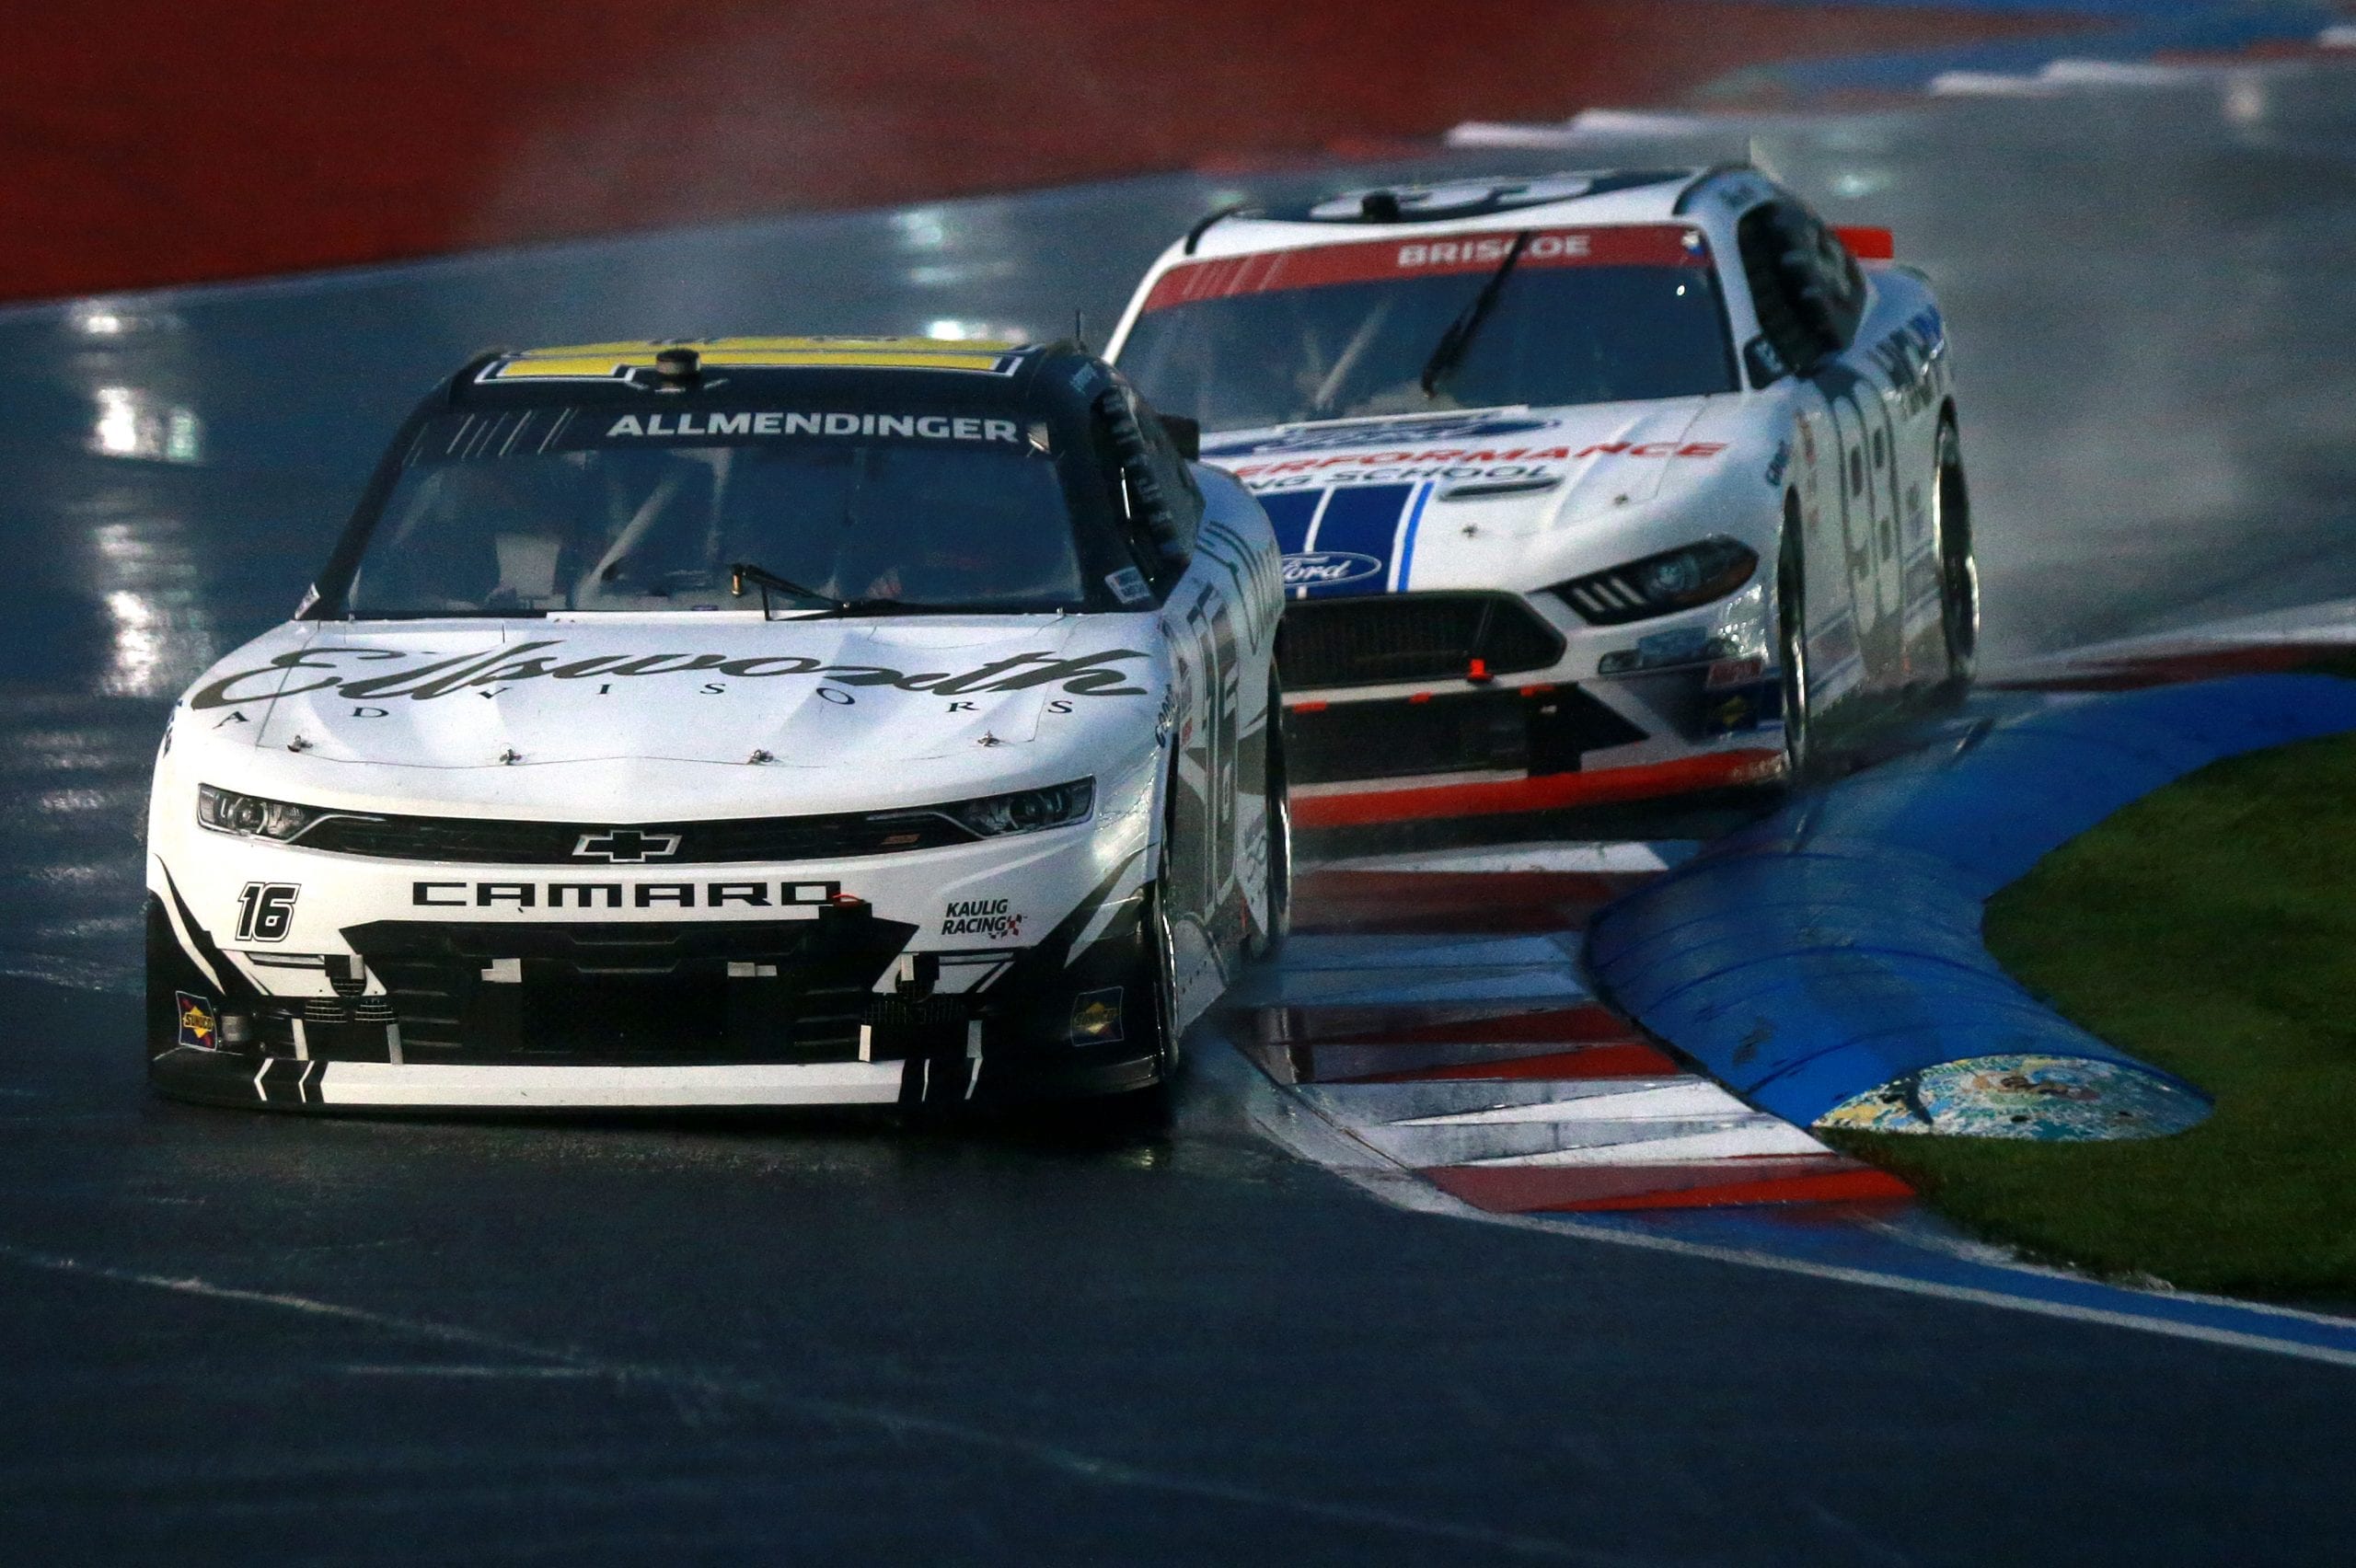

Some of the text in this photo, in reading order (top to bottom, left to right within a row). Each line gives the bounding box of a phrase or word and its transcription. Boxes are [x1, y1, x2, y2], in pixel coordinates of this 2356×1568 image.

[606, 412, 1020, 443] ALLMENDINGER
[1234, 441, 1728, 477] ERFORMANCE
[1324, 465, 1549, 484] SCHOOL
[191, 640, 1150, 709] Ellsworth
[213, 683, 1073, 729] ADVISORS
[412, 881, 841, 907] CAMARO
[945, 899, 1009, 918] KAULIG
[237, 882, 301, 942] 16
[941, 916, 1007, 936] RACING
